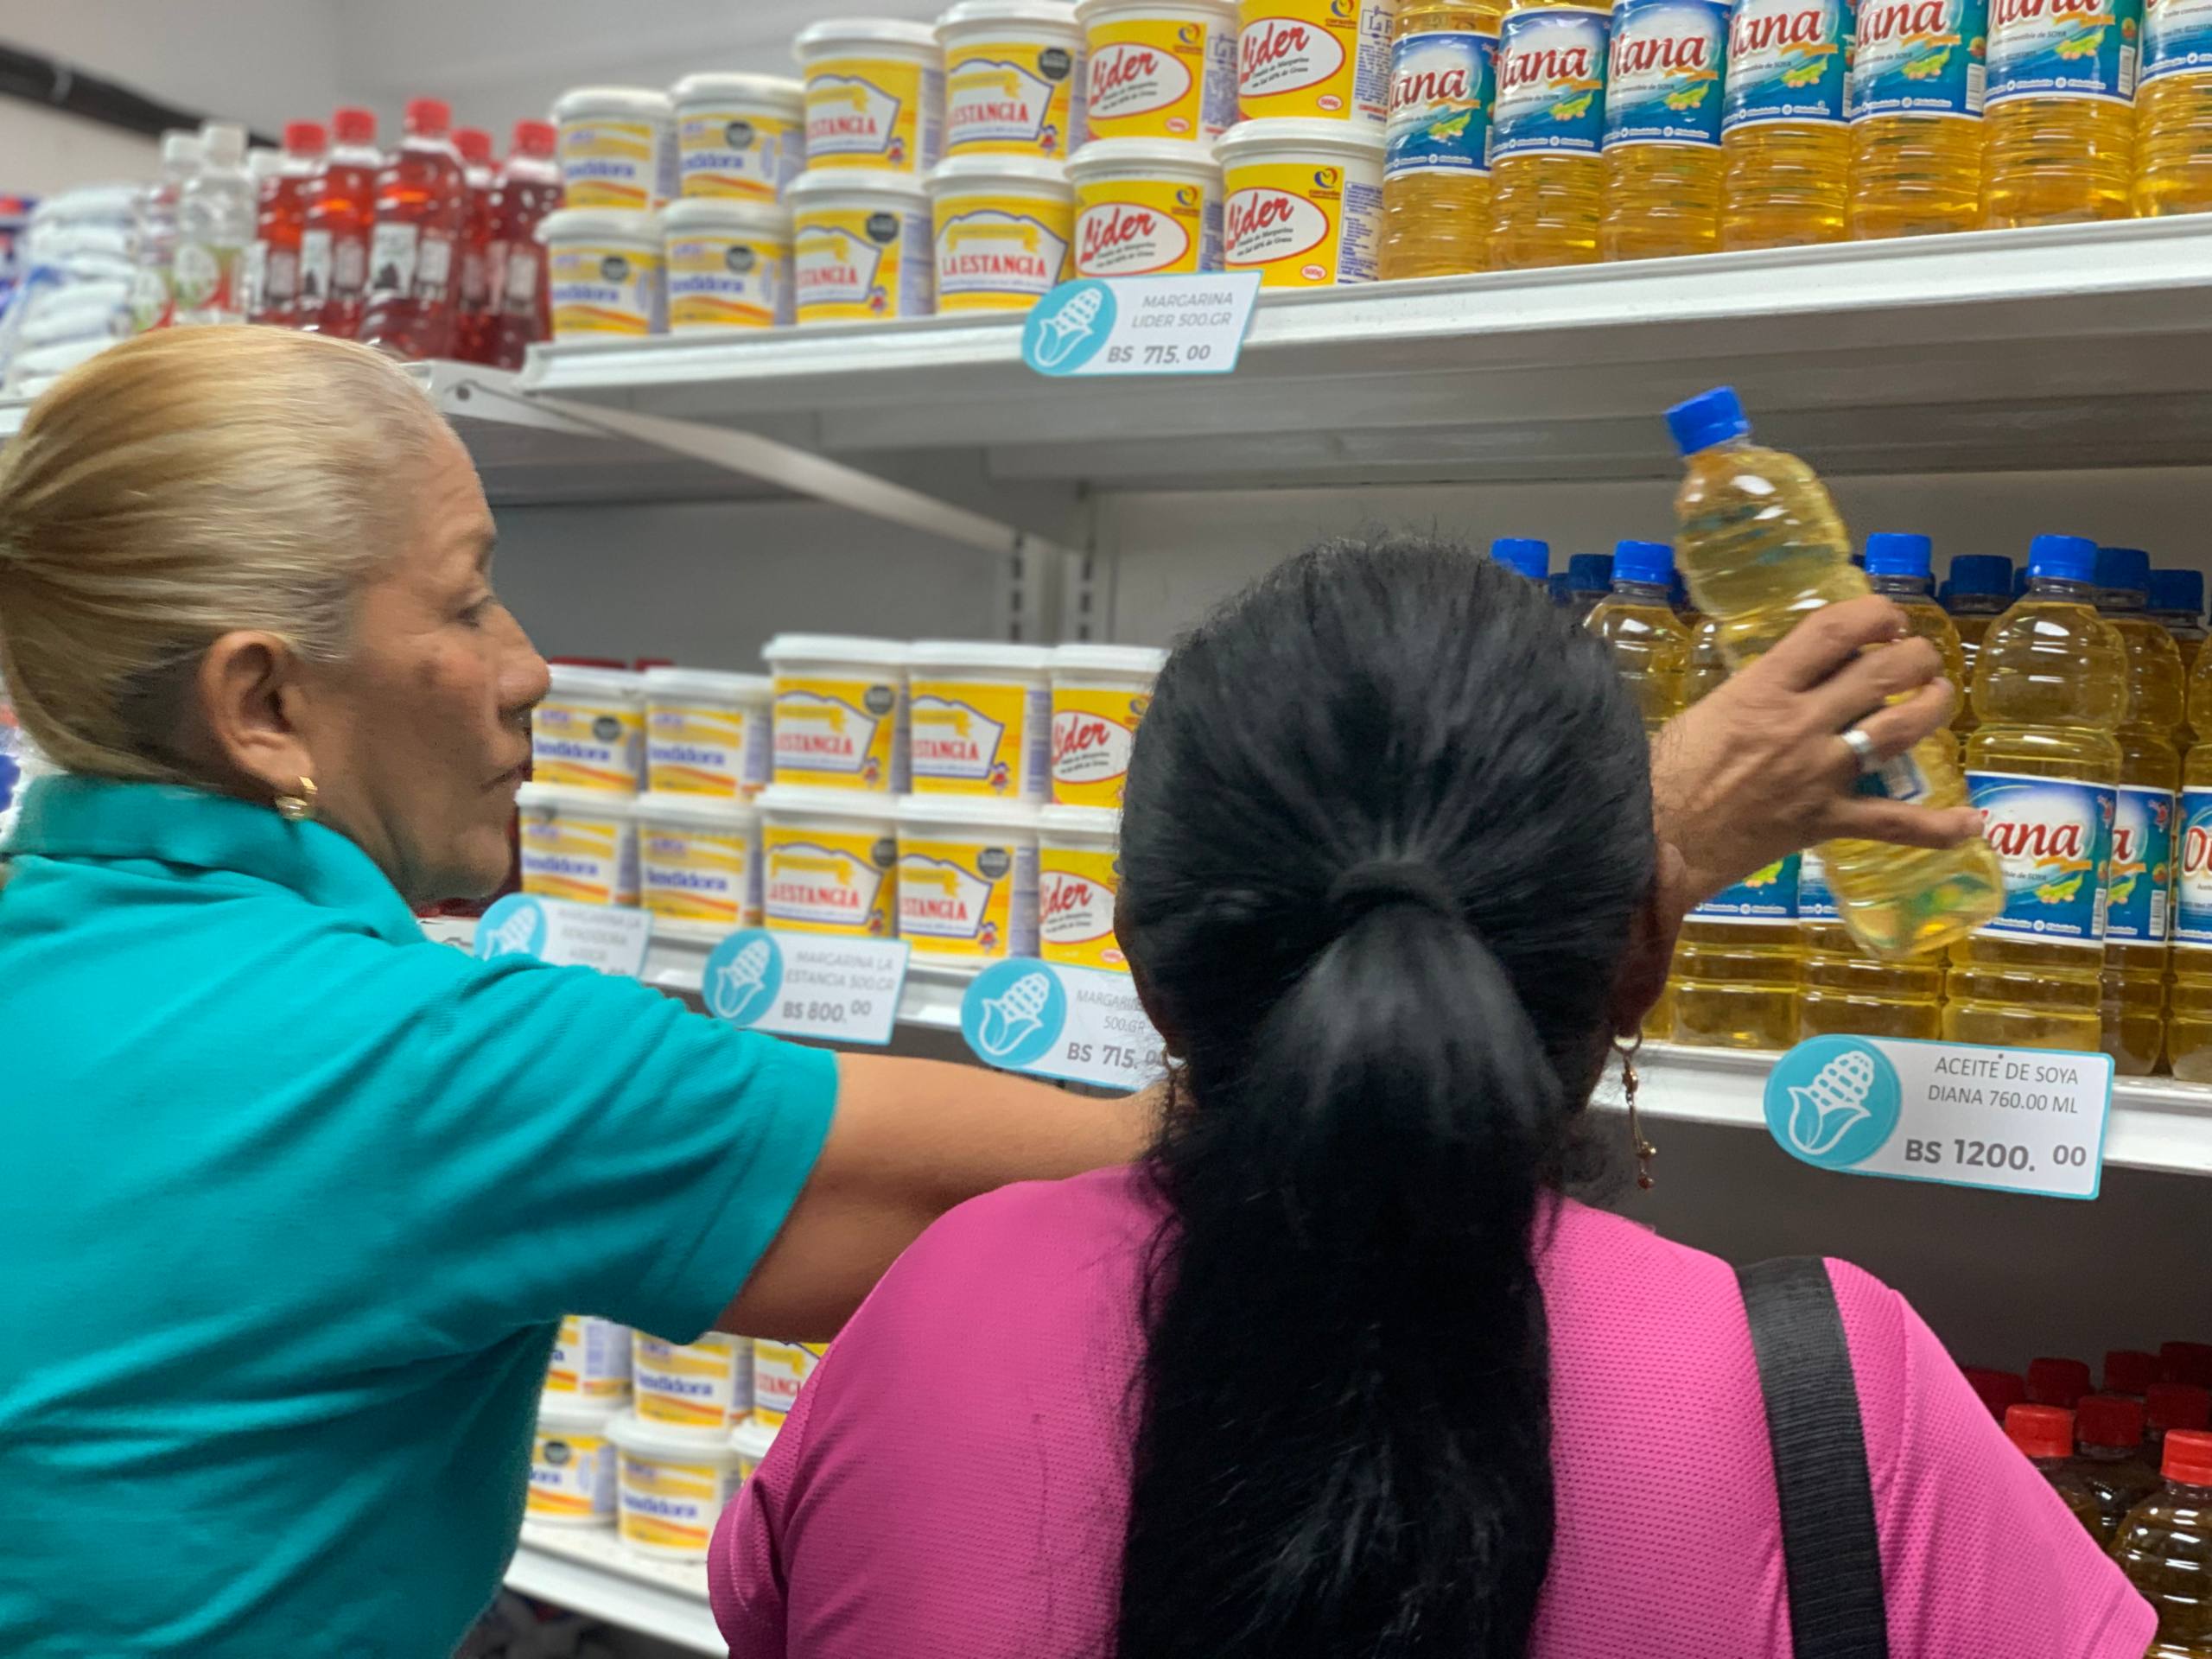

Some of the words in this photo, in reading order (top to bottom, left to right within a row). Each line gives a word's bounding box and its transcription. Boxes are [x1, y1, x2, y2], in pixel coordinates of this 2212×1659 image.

[1389, 70, 1468, 112] iana
[960, 254, 1047, 278] ESTANCIA
[1142, 292, 1234, 308] MARGARINA
[1132, 315, 1174, 328] LIDER
[1107, 346, 1134, 363] BS
[1186, 344, 1211, 360] 00
[797, 951, 874, 968] MARGARINA
[786, 968, 846, 987] ESTANCIA
[782, 1001, 804, 1020] BS
[850, 999, 873, 1016] 00
[1077, 988, 1143, 1012] MARGARIN
[1067, 1042, 1092, 1063] BS
[1934, 1057, 1999, 1079] ACEITE
[2005, 1062, 2031, 1083] DE
[2035, 1066, 2079, 1084] SOYA
[1928, 1084, 1983, 1106] DIANA
[1989, 1090, 2048, 1112] 760.00
[2052, 1097, 2078, 1114] ML
[1904, 1139, 1942, 1164] BS
[1953, 1139, 2036, 1172] 1200.
[2052, 1144, 2087, 1167] 00
